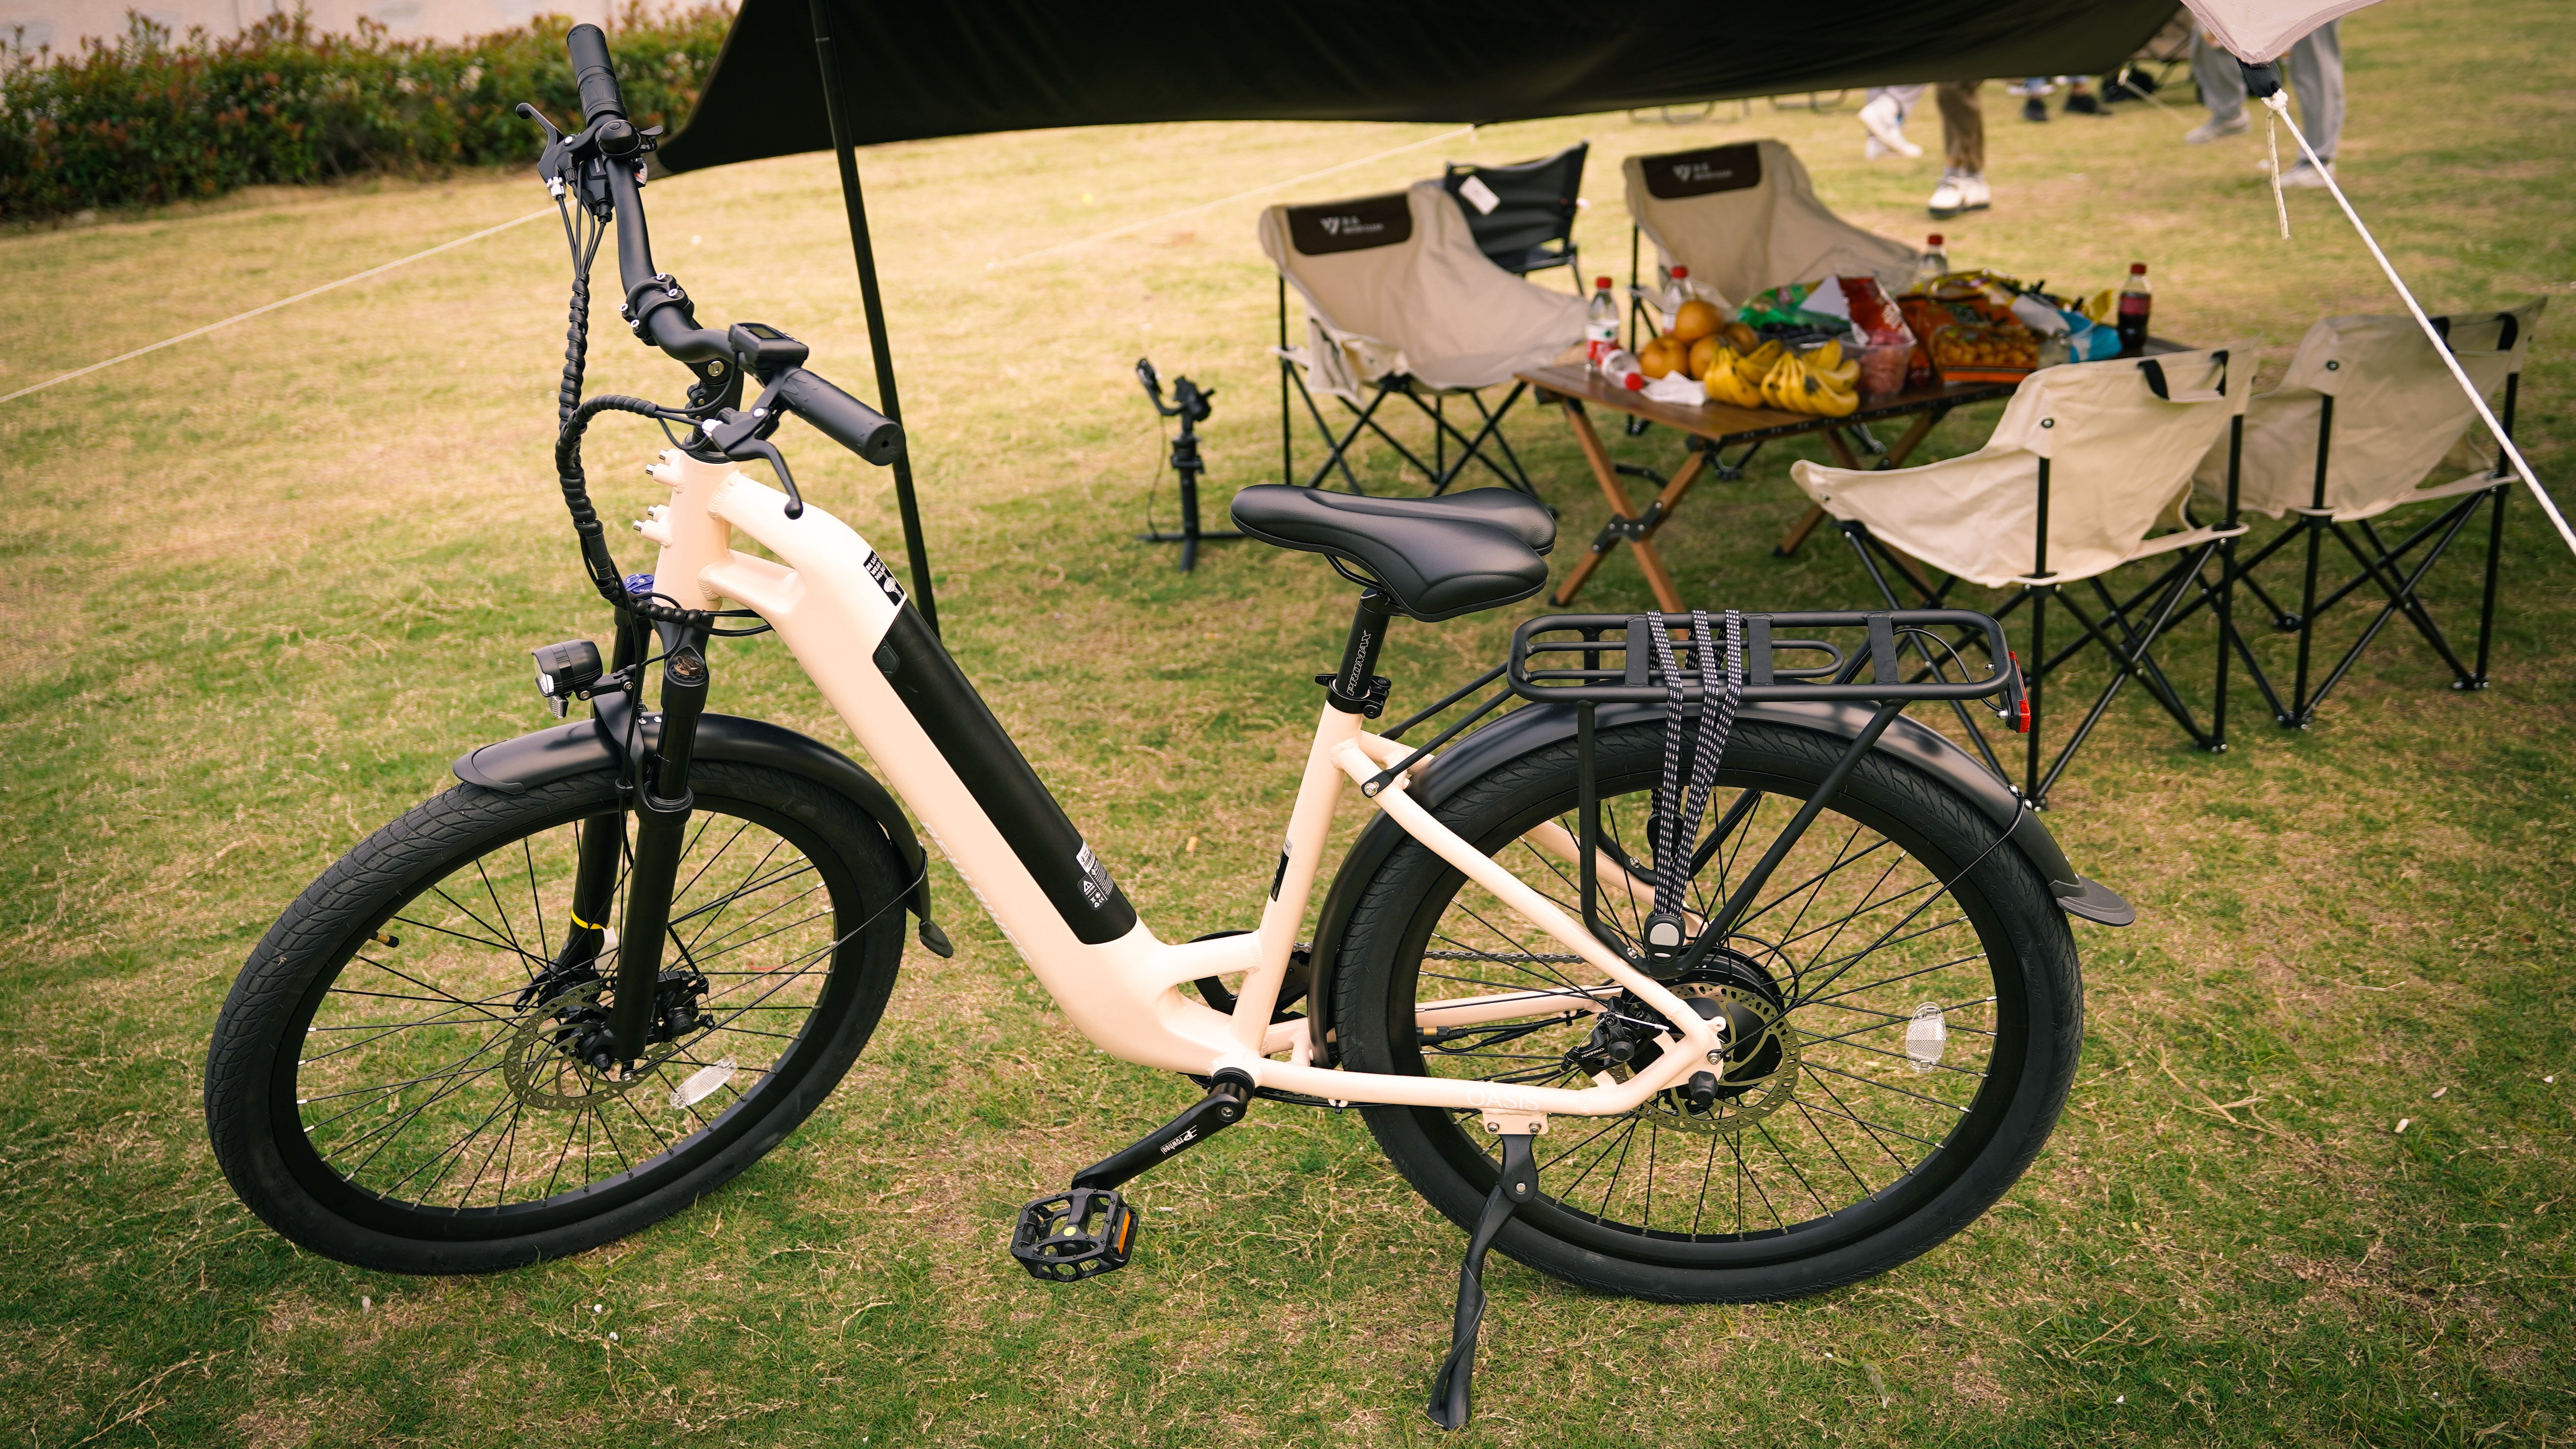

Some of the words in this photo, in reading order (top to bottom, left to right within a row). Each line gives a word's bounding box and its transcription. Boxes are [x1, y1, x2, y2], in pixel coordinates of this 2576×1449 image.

[865, 562, 873, 570] BE
[1347, 629, 1371, 696] PROMAX
[1467, 1087, 1539, 1110] OASIS
[1159, 1125, 1197, 1155] Prowheel
